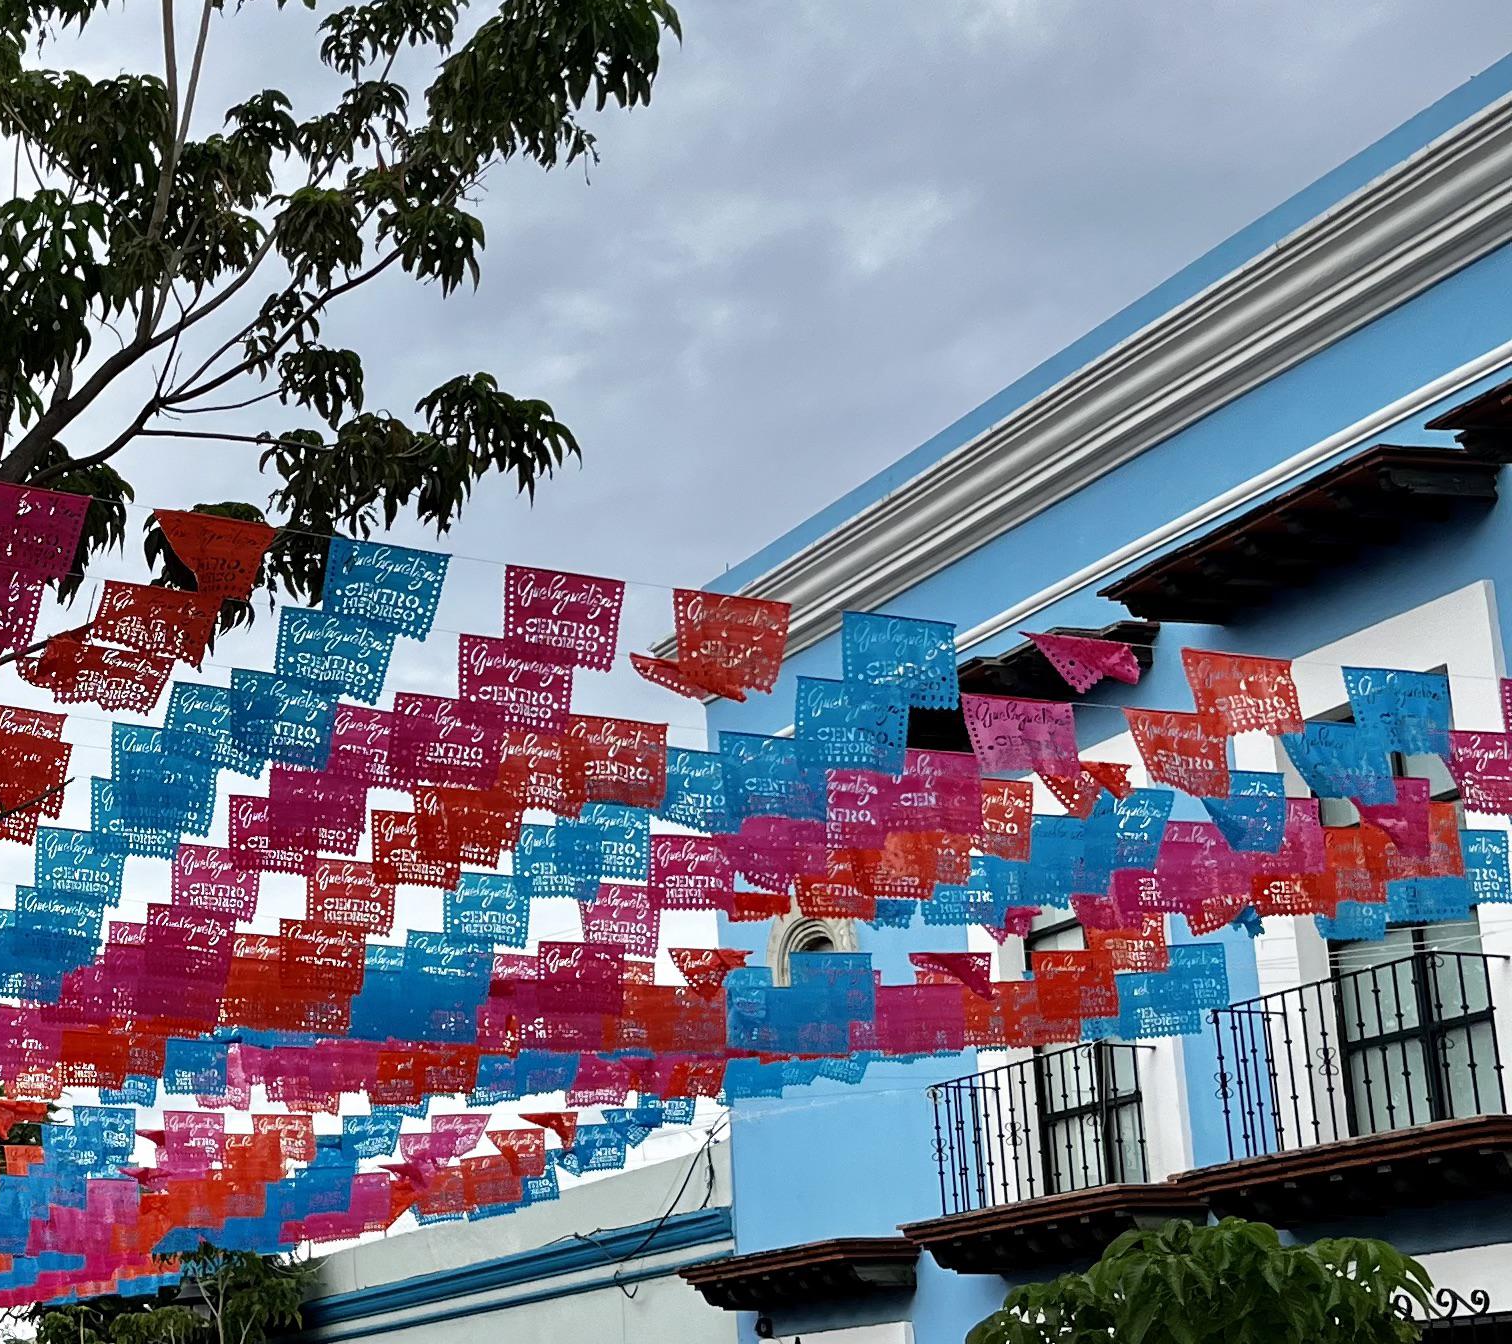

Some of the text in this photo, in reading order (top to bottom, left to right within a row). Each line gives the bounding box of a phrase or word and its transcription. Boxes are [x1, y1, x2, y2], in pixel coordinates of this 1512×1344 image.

[345, 582, 419, 608] CENTRO
[518, 573, 615, 619] Guelaguetza
[291, 617, 384, 657] Guelaguetza
[526, 618, 600, 639] CENTRO
[854, 621, 948, 660] Guelaguetza
[298, 653, 369, 675] CENTRO
[471, 644, 565, 687] Guelaguetza
[479, 686, 552, 704] CENTRO
[1216, 695, 1285, 709] CENTRO
[585, 760, 649, 780] CENTRO
[678, 791, 725, 806] ENTRO
[826, 808, 872, 823] NTRO
[53, 866, 110, 883] CENTRO
[666, 876, 723, 888] CENTRO
[190, 884, 245, 898] CENTRO
[324, 898, 381, 912] CENTRO
[461, 911, 517, 924] CENTRO
[590, 921, 647, 934] CENTRO
